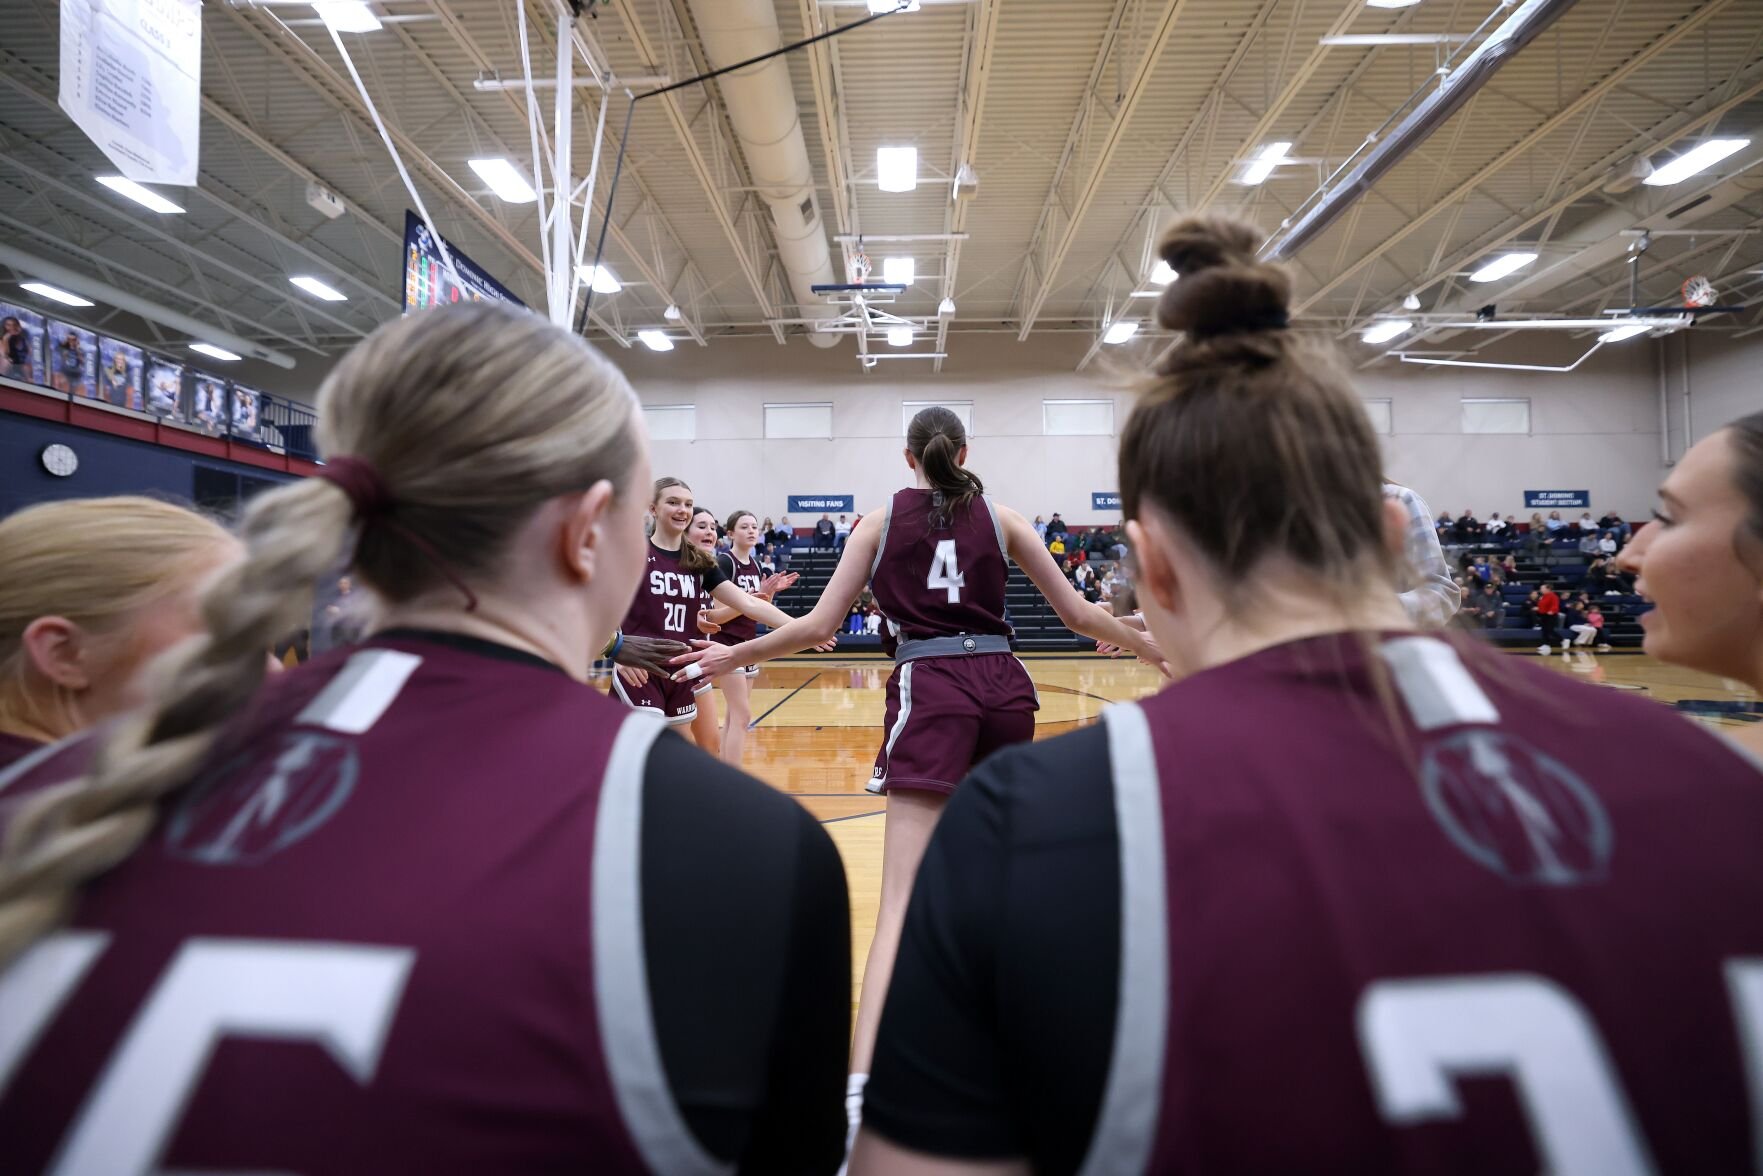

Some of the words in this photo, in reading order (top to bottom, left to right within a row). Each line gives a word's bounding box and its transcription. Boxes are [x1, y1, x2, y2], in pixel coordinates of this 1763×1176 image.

[797, 500, 825, 508] VISITING
[826, 500, 844, 508] FANS
[1096, 497, 1106, 505] ST.
[649, 570, 696, 599] SCW
[927, 538, 966, 604] 4
[663, 601, 687, 633] 20
